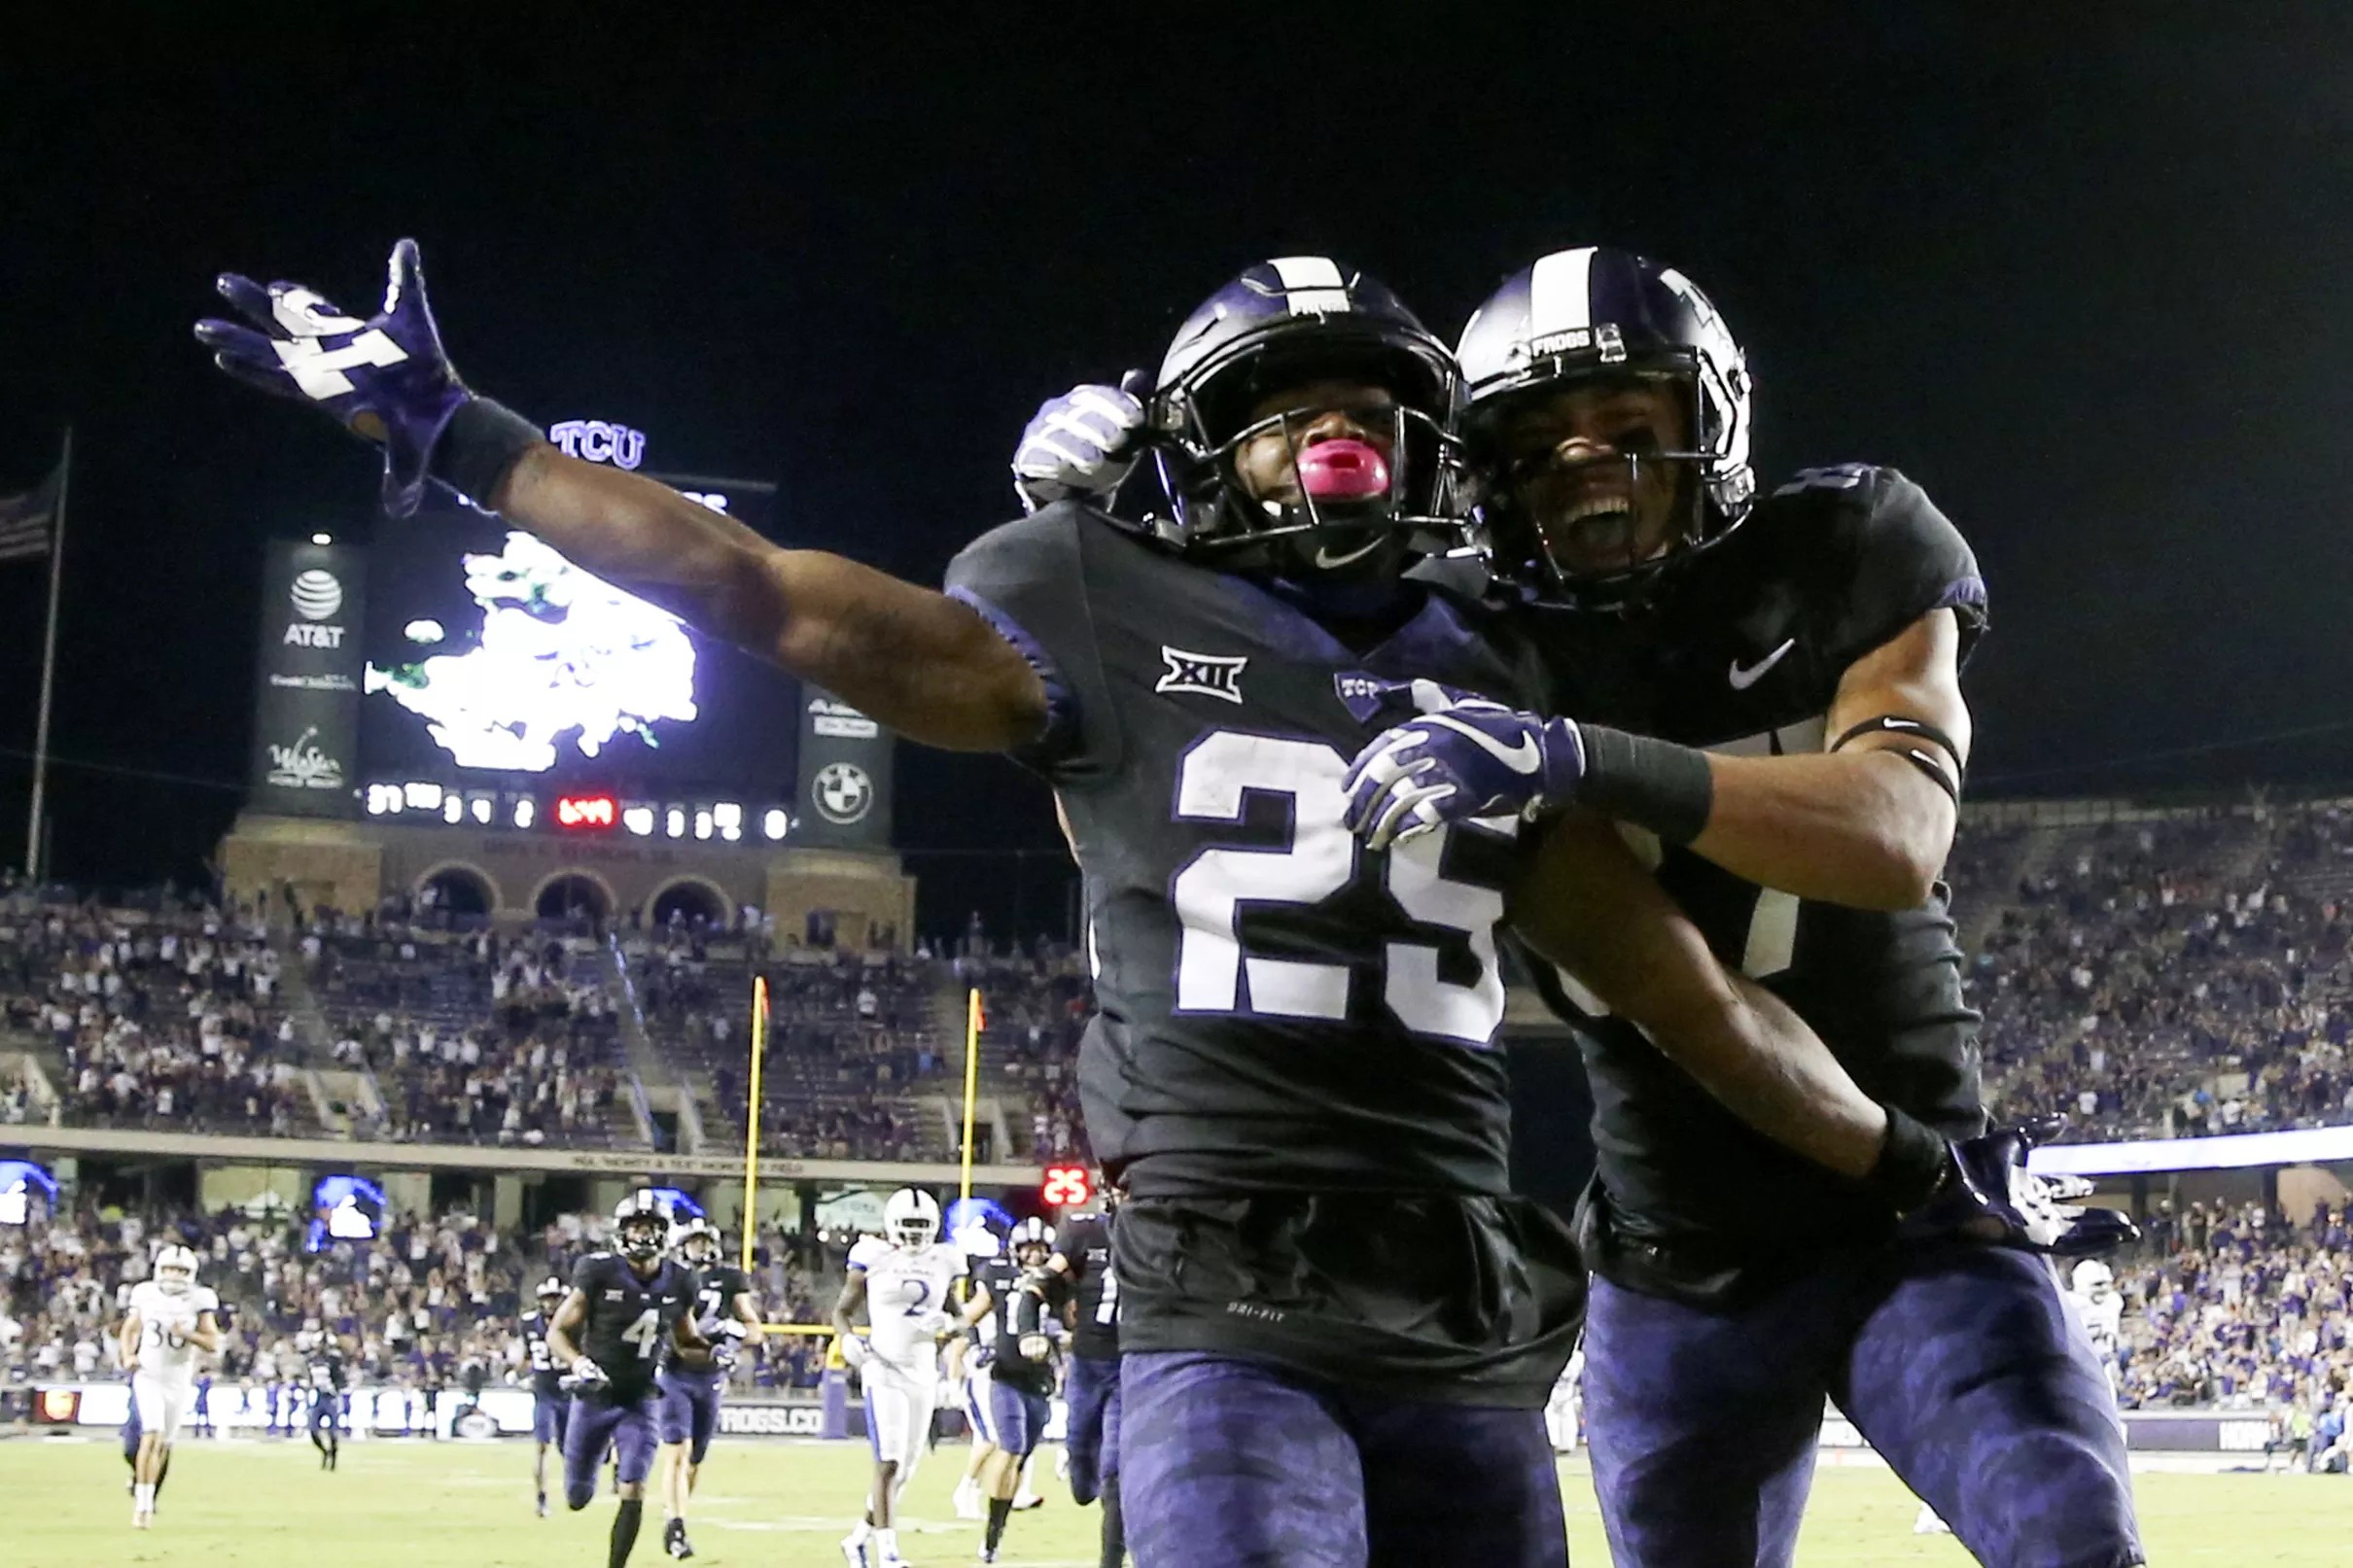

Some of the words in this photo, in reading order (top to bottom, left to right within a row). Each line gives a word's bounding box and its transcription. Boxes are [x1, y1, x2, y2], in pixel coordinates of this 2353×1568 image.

[1532, 330, 1591, 357] FROGS
[550, 420, 646, 470] TCU
[283, 623, 345, 648] AT&T
[1174, 730, 1505, 1043] 25
[1044, 1168, 1087, 1204] 25
[901, 1279, 931, 1316] 2
[621, 1308, 659, 1358] 4
